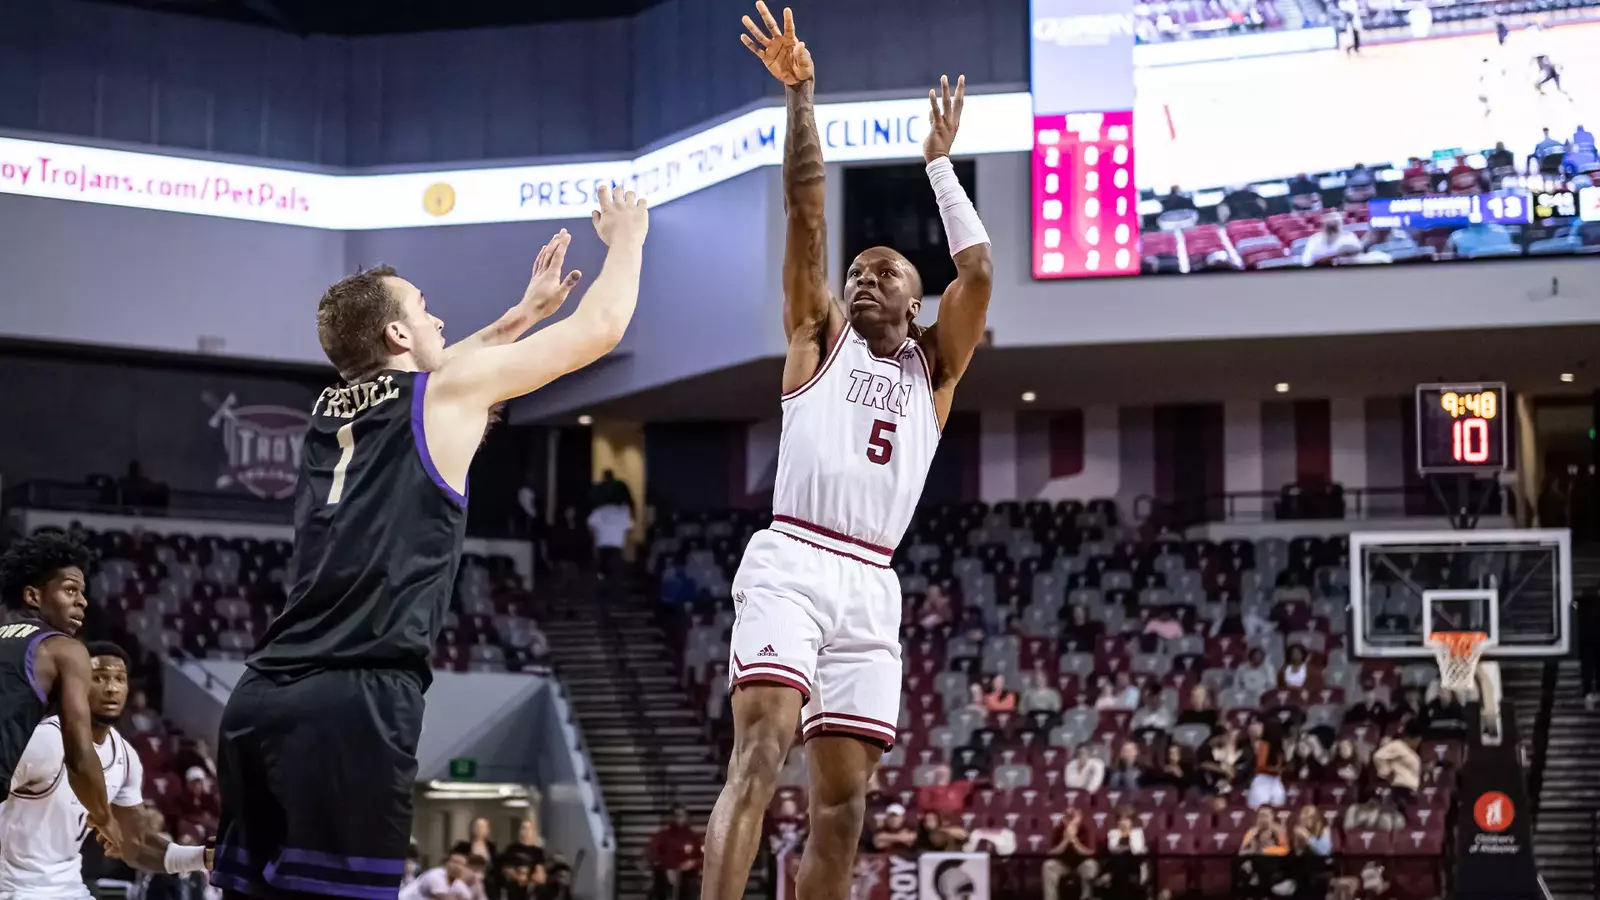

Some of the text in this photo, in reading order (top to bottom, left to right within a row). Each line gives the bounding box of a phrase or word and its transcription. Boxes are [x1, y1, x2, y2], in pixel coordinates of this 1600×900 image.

[826, 115, 919, 148] CLINIC
[1487, 197, 1522, 219] 13
[1441, 391, 1496, 419] 9:48
[238, 430, 305, 468] TROY
[866, 419, 897, 465] 5
[1453, 418, 1488, 462] 10
[327, 422, 354, 504] 1
